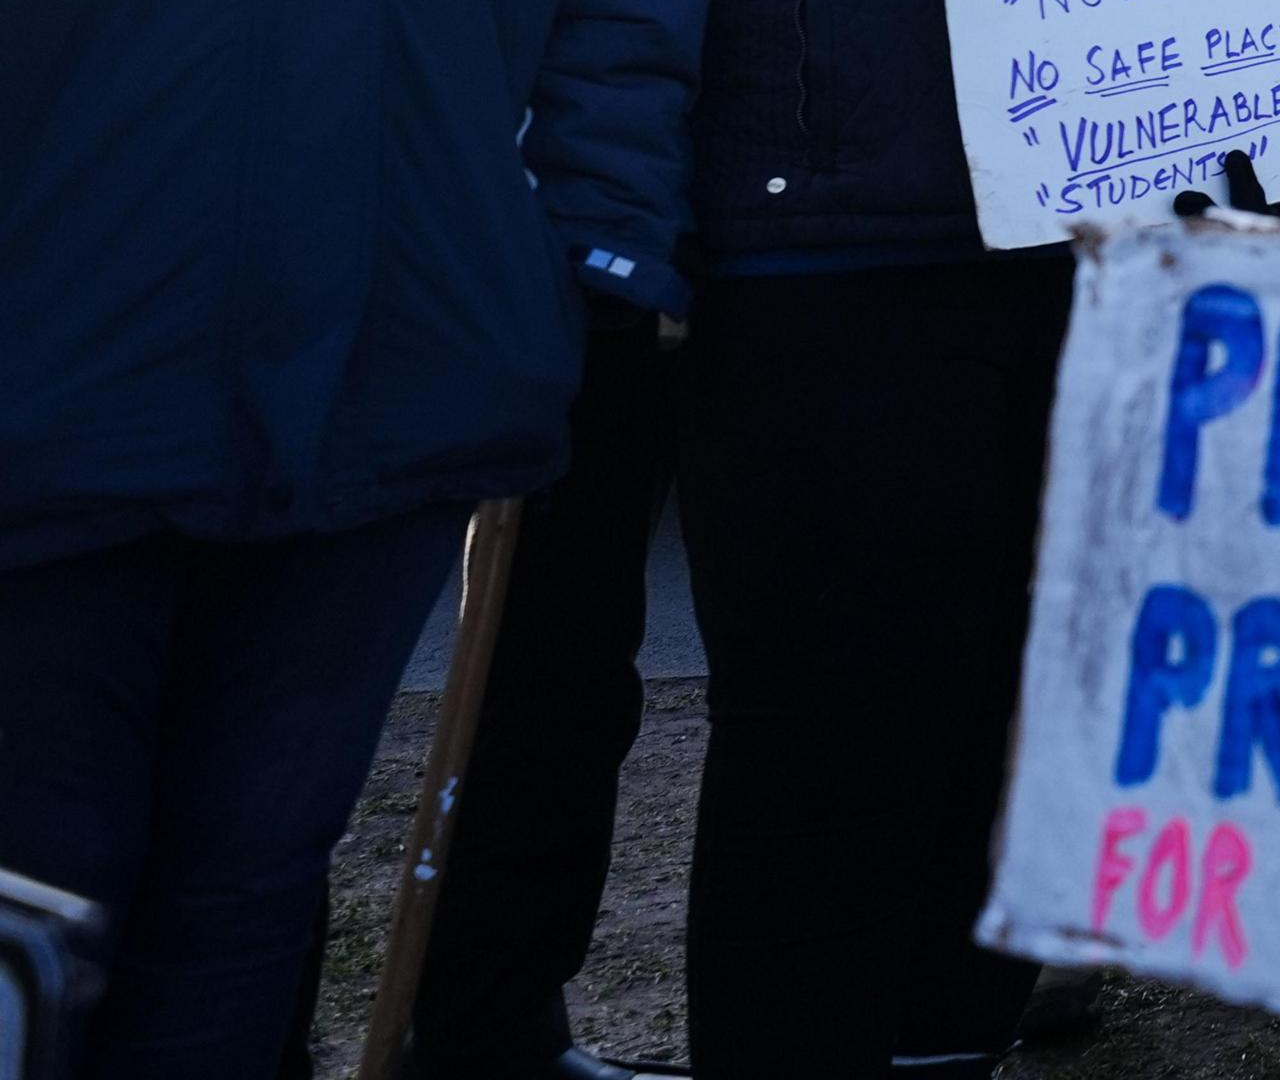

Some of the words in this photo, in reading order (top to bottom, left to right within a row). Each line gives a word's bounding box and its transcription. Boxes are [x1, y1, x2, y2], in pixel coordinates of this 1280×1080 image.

[1009, 50, 1059, 99] NO
[1084, 37, 1183, 85] SAFE
[1092, 808, 1254, 974] FOR
